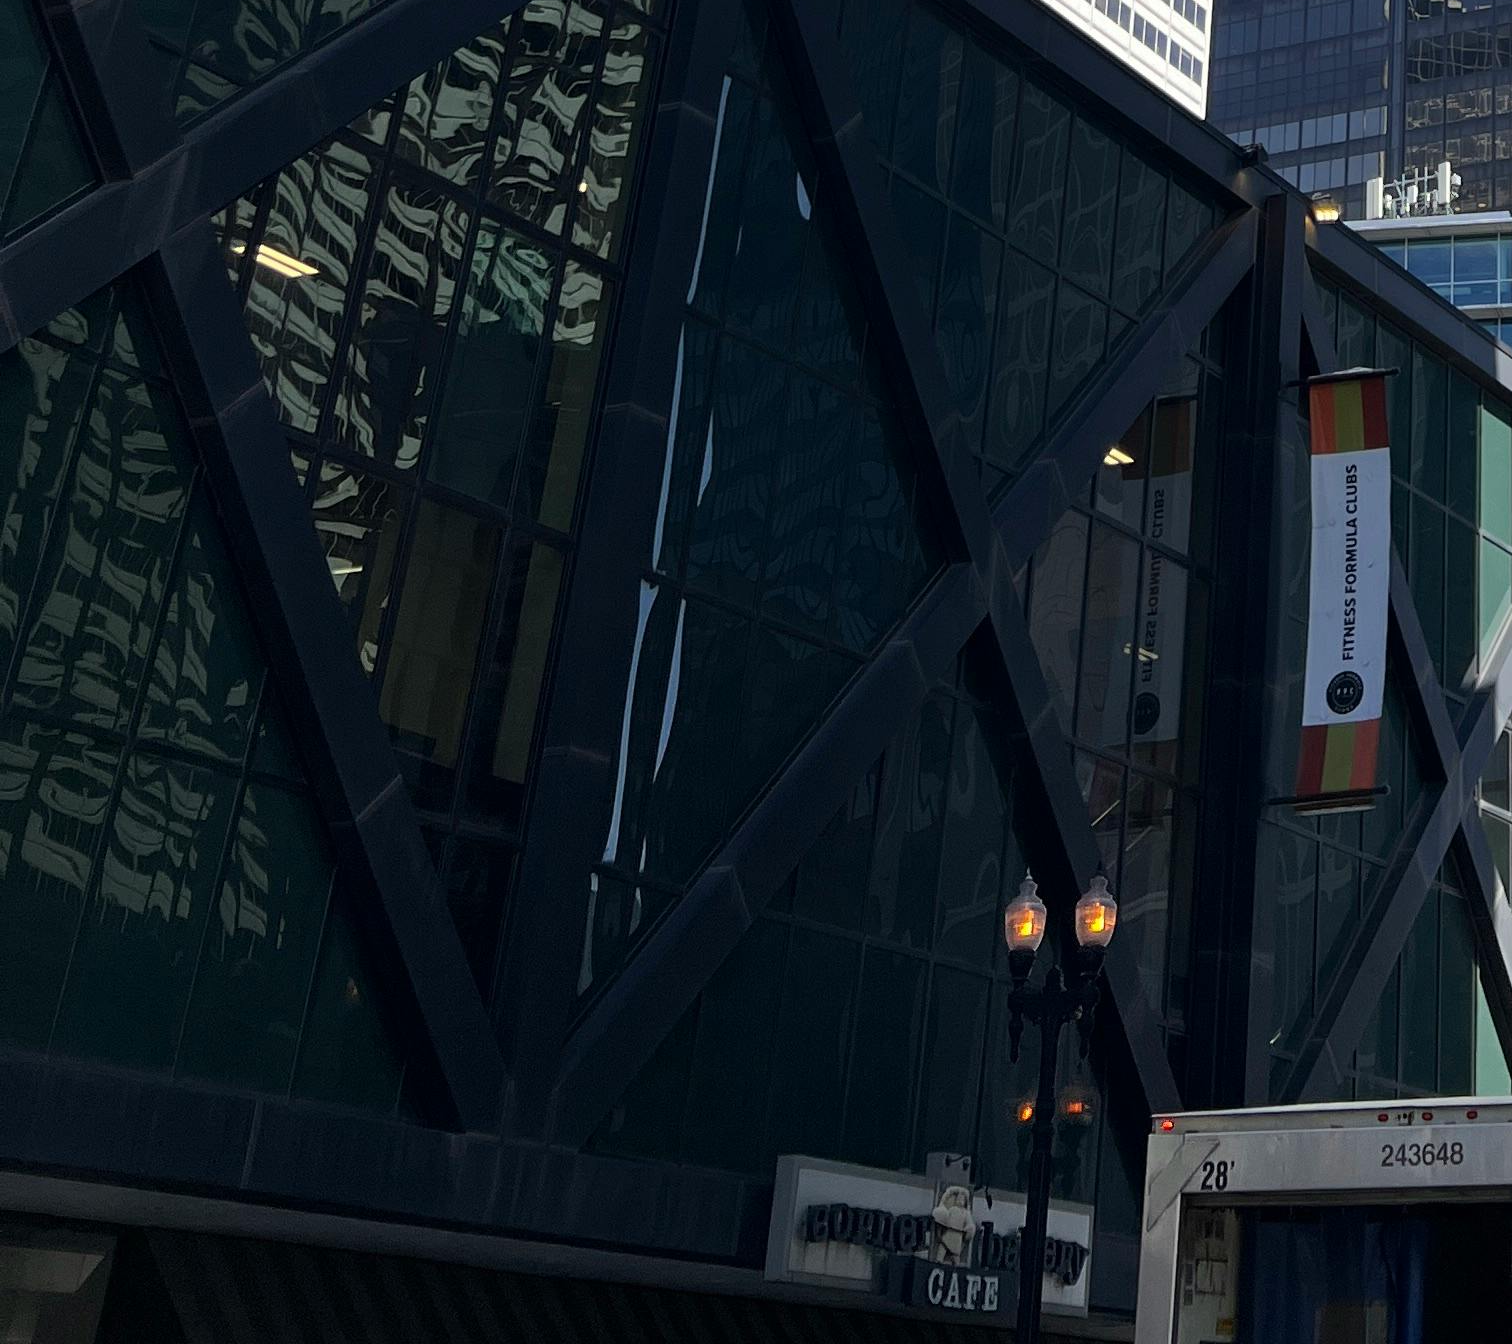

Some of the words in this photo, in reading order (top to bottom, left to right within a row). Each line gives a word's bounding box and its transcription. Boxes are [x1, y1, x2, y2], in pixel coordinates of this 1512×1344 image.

[1345, 463, 1358, 514] CLUBS
[1344, 517, 1358, 593] FORMULA
[1342, 598, 1357, 662] FITNESS
[1200, 1160, 1235, 1191] 28'
[1381, 1141, 1464, 1167] 243648
[976, 1220, 1090, 1286] baery
[927, 1267, 1000, 1312] CAFE
